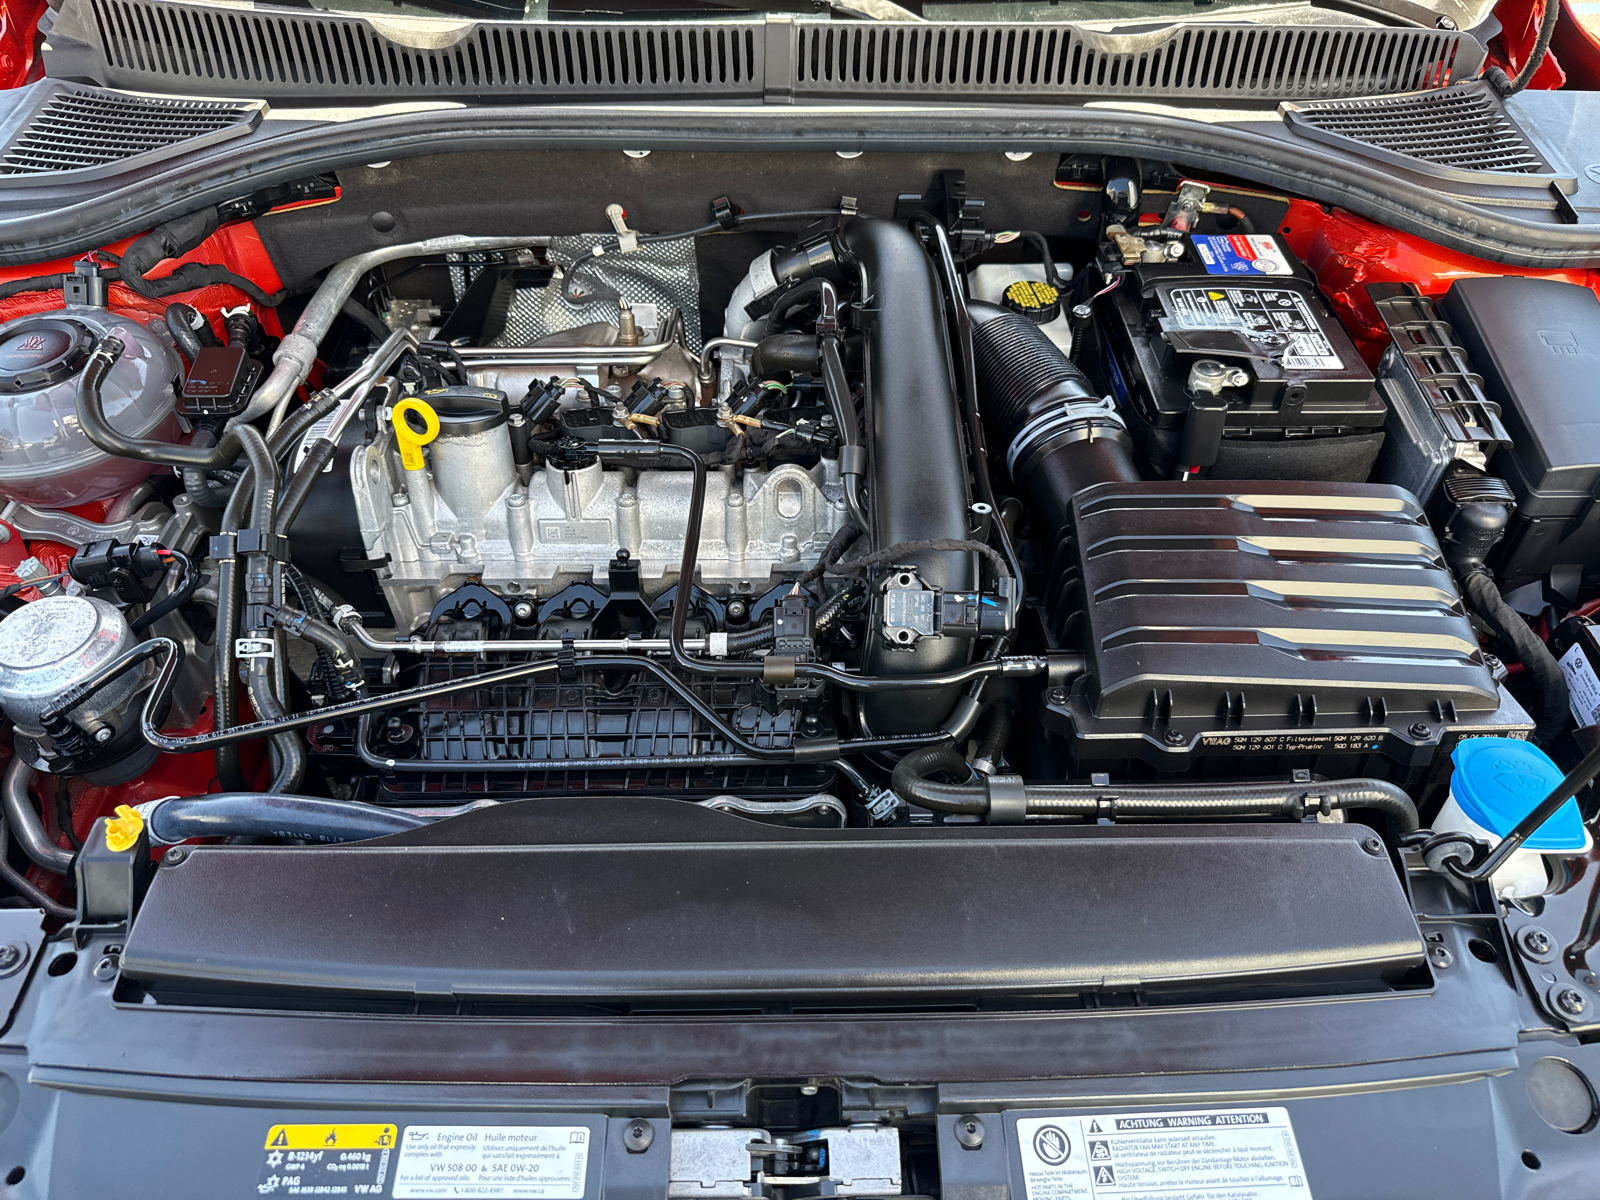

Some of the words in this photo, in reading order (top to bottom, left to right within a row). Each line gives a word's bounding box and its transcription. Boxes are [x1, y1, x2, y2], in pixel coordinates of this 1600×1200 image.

[1120, 1118, 1163, 1129] ACHTUNG
[1167, 1116, 1212, 1127] WARNING
[1216, 1113, 1264, 1124] ATTENTION
[437, 1133, 464, 1143] Engine
[466, 1133, 478, 1141] Oil
[484, 1133, 506, 1141] Huile
[287, 1151, 324, 1164] R-1234yf
[340, 1152, 361, 1160] 0.460
[362, 1152, 372, 1162] kg
[430, 1163, 446, 1172] VW
[447, 1163, 463, 1172] 508
[465, 1163, 477, 1172] 00
[492, 1164, 508, 1172] SAE
[510, 1164, 539, 1172] 0W-20
[282, 1176, 301, 1186] PAG
[354, 1185, 368, 1193] VW
[369, 1185, 382, 1193] AG
